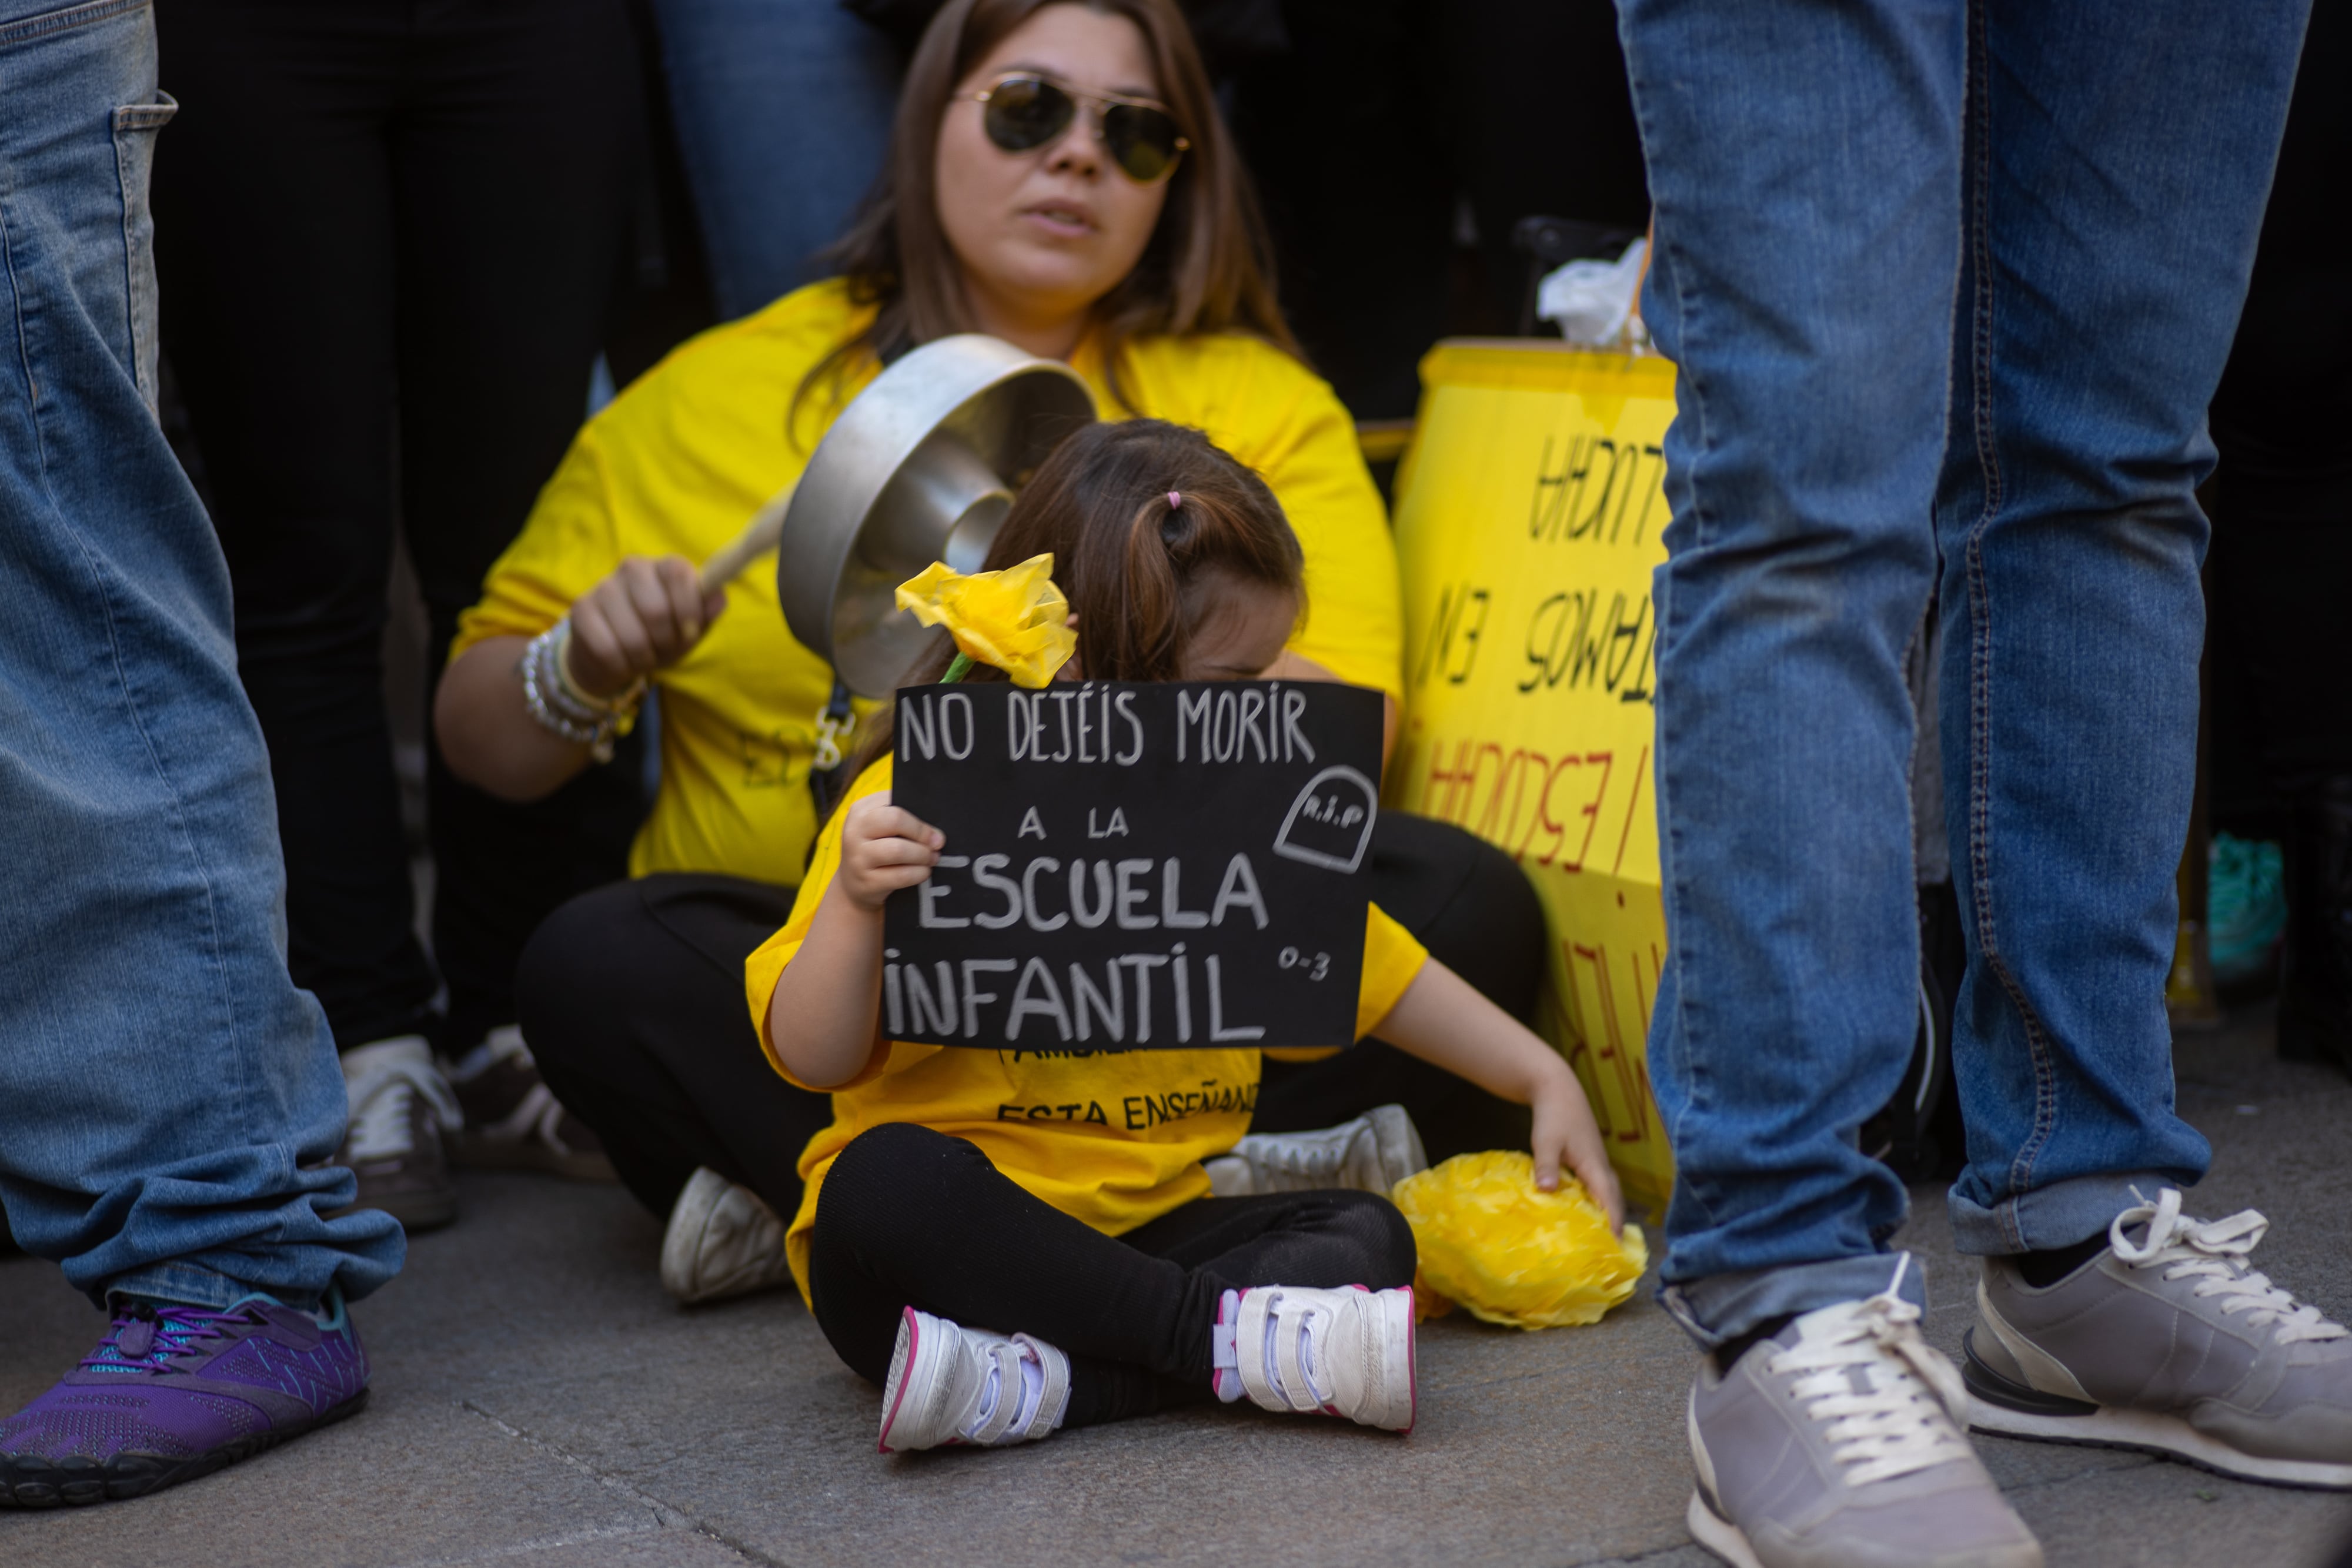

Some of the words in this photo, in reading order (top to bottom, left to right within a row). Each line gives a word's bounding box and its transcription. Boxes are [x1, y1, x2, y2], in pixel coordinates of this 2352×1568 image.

[1530, 433, 1663, 547] LUCHA
[1414, 580, 1490, 688] EN
[1518, 587, 1655, 704] TAMOS
[900, 692, 974, 763] NO
[1008, 681, 1144, 766] DEJÉIS
[1177, 681, 1316, 764] MORIR
[1018, 805, 1047, 841] A
[1088, 807, 1130, 840] LA
[919, 852, 1269, 931] ESCUELA
[884, 942, 1266, 1044] INFANTIL
[1278, 946, 1331, 981] 0-3
